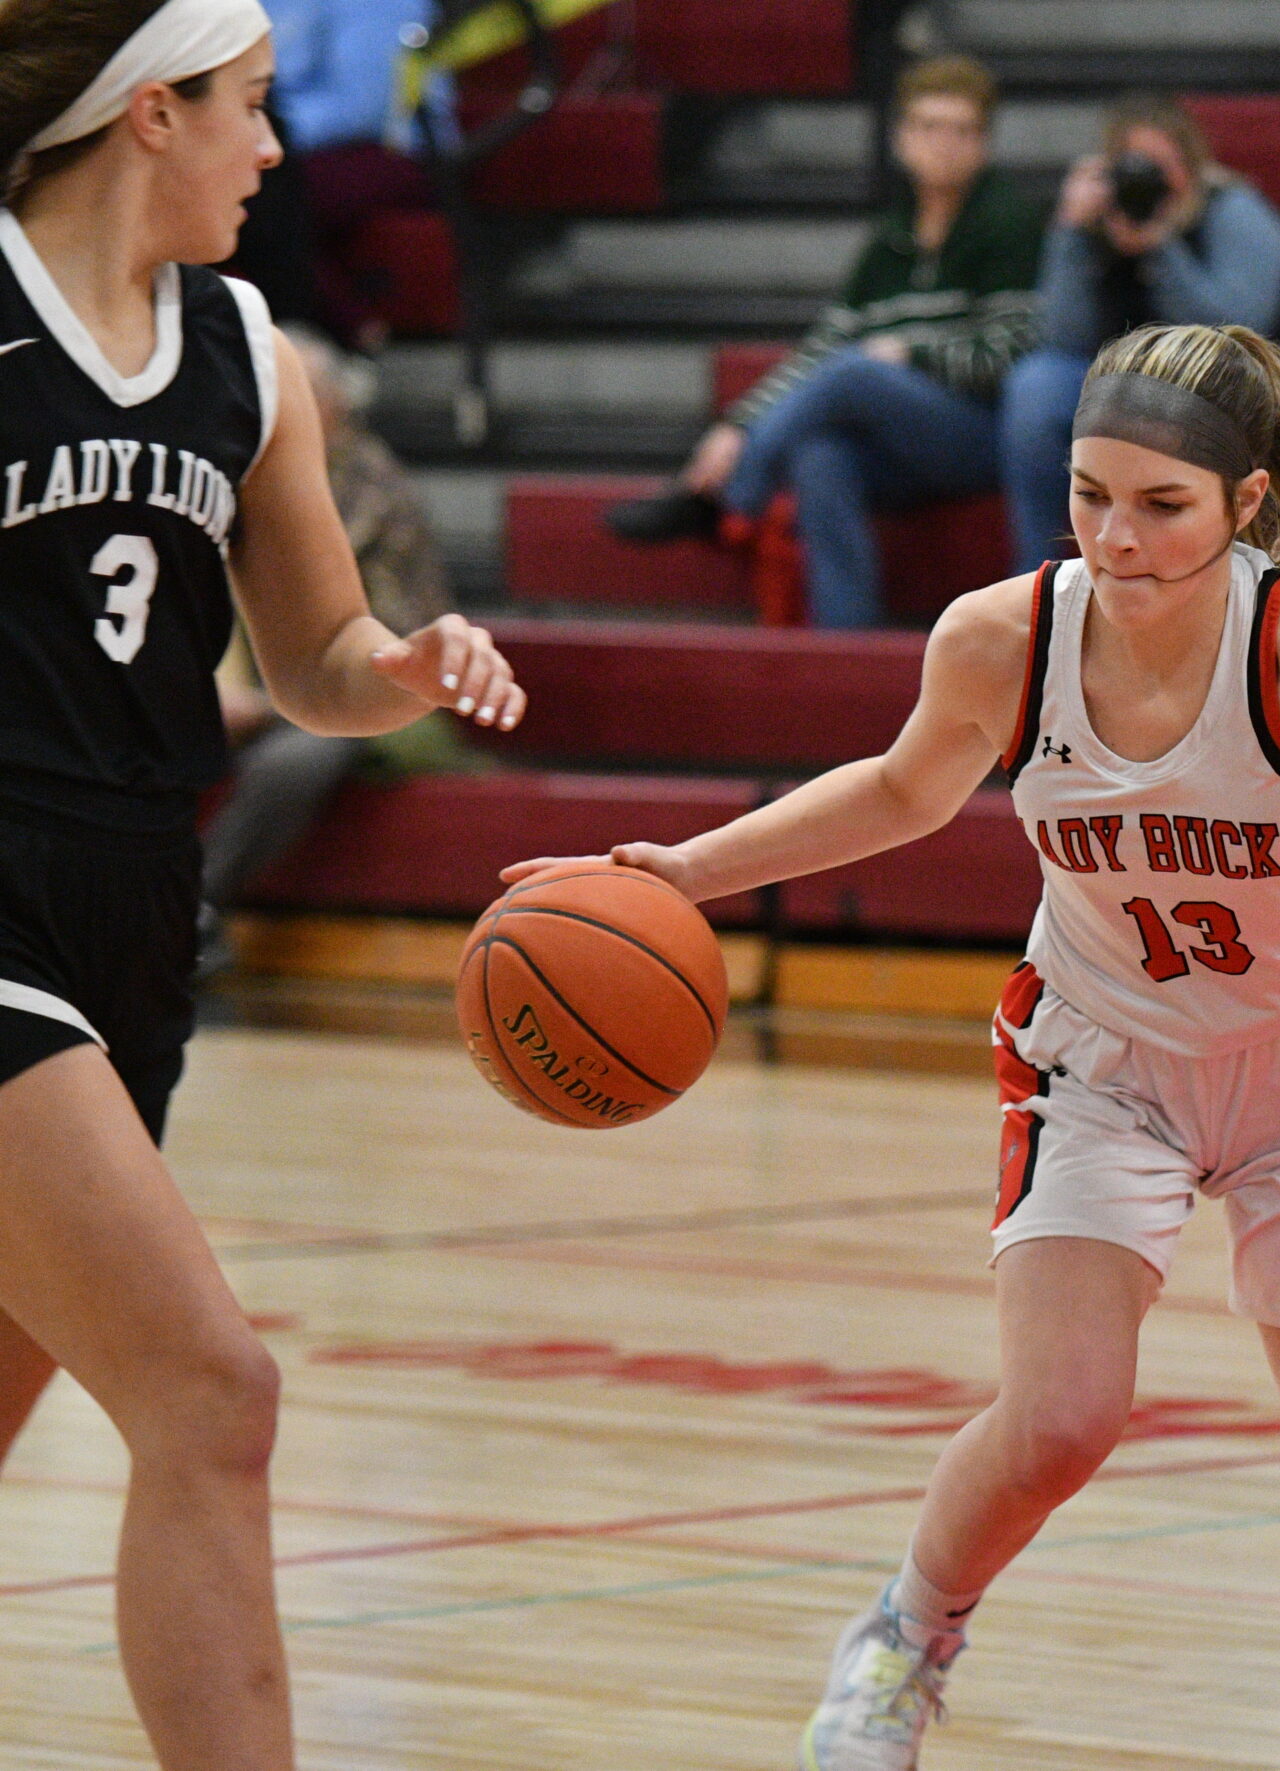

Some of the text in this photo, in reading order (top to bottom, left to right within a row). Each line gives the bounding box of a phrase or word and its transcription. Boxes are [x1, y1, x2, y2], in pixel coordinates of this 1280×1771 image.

[1, 439, 237, 560] LADY LION
[89, 533, 159, 665] 3
[1121, 896, 1256, 983] 13
[502, 1003, 645, 1123] SPALDING
